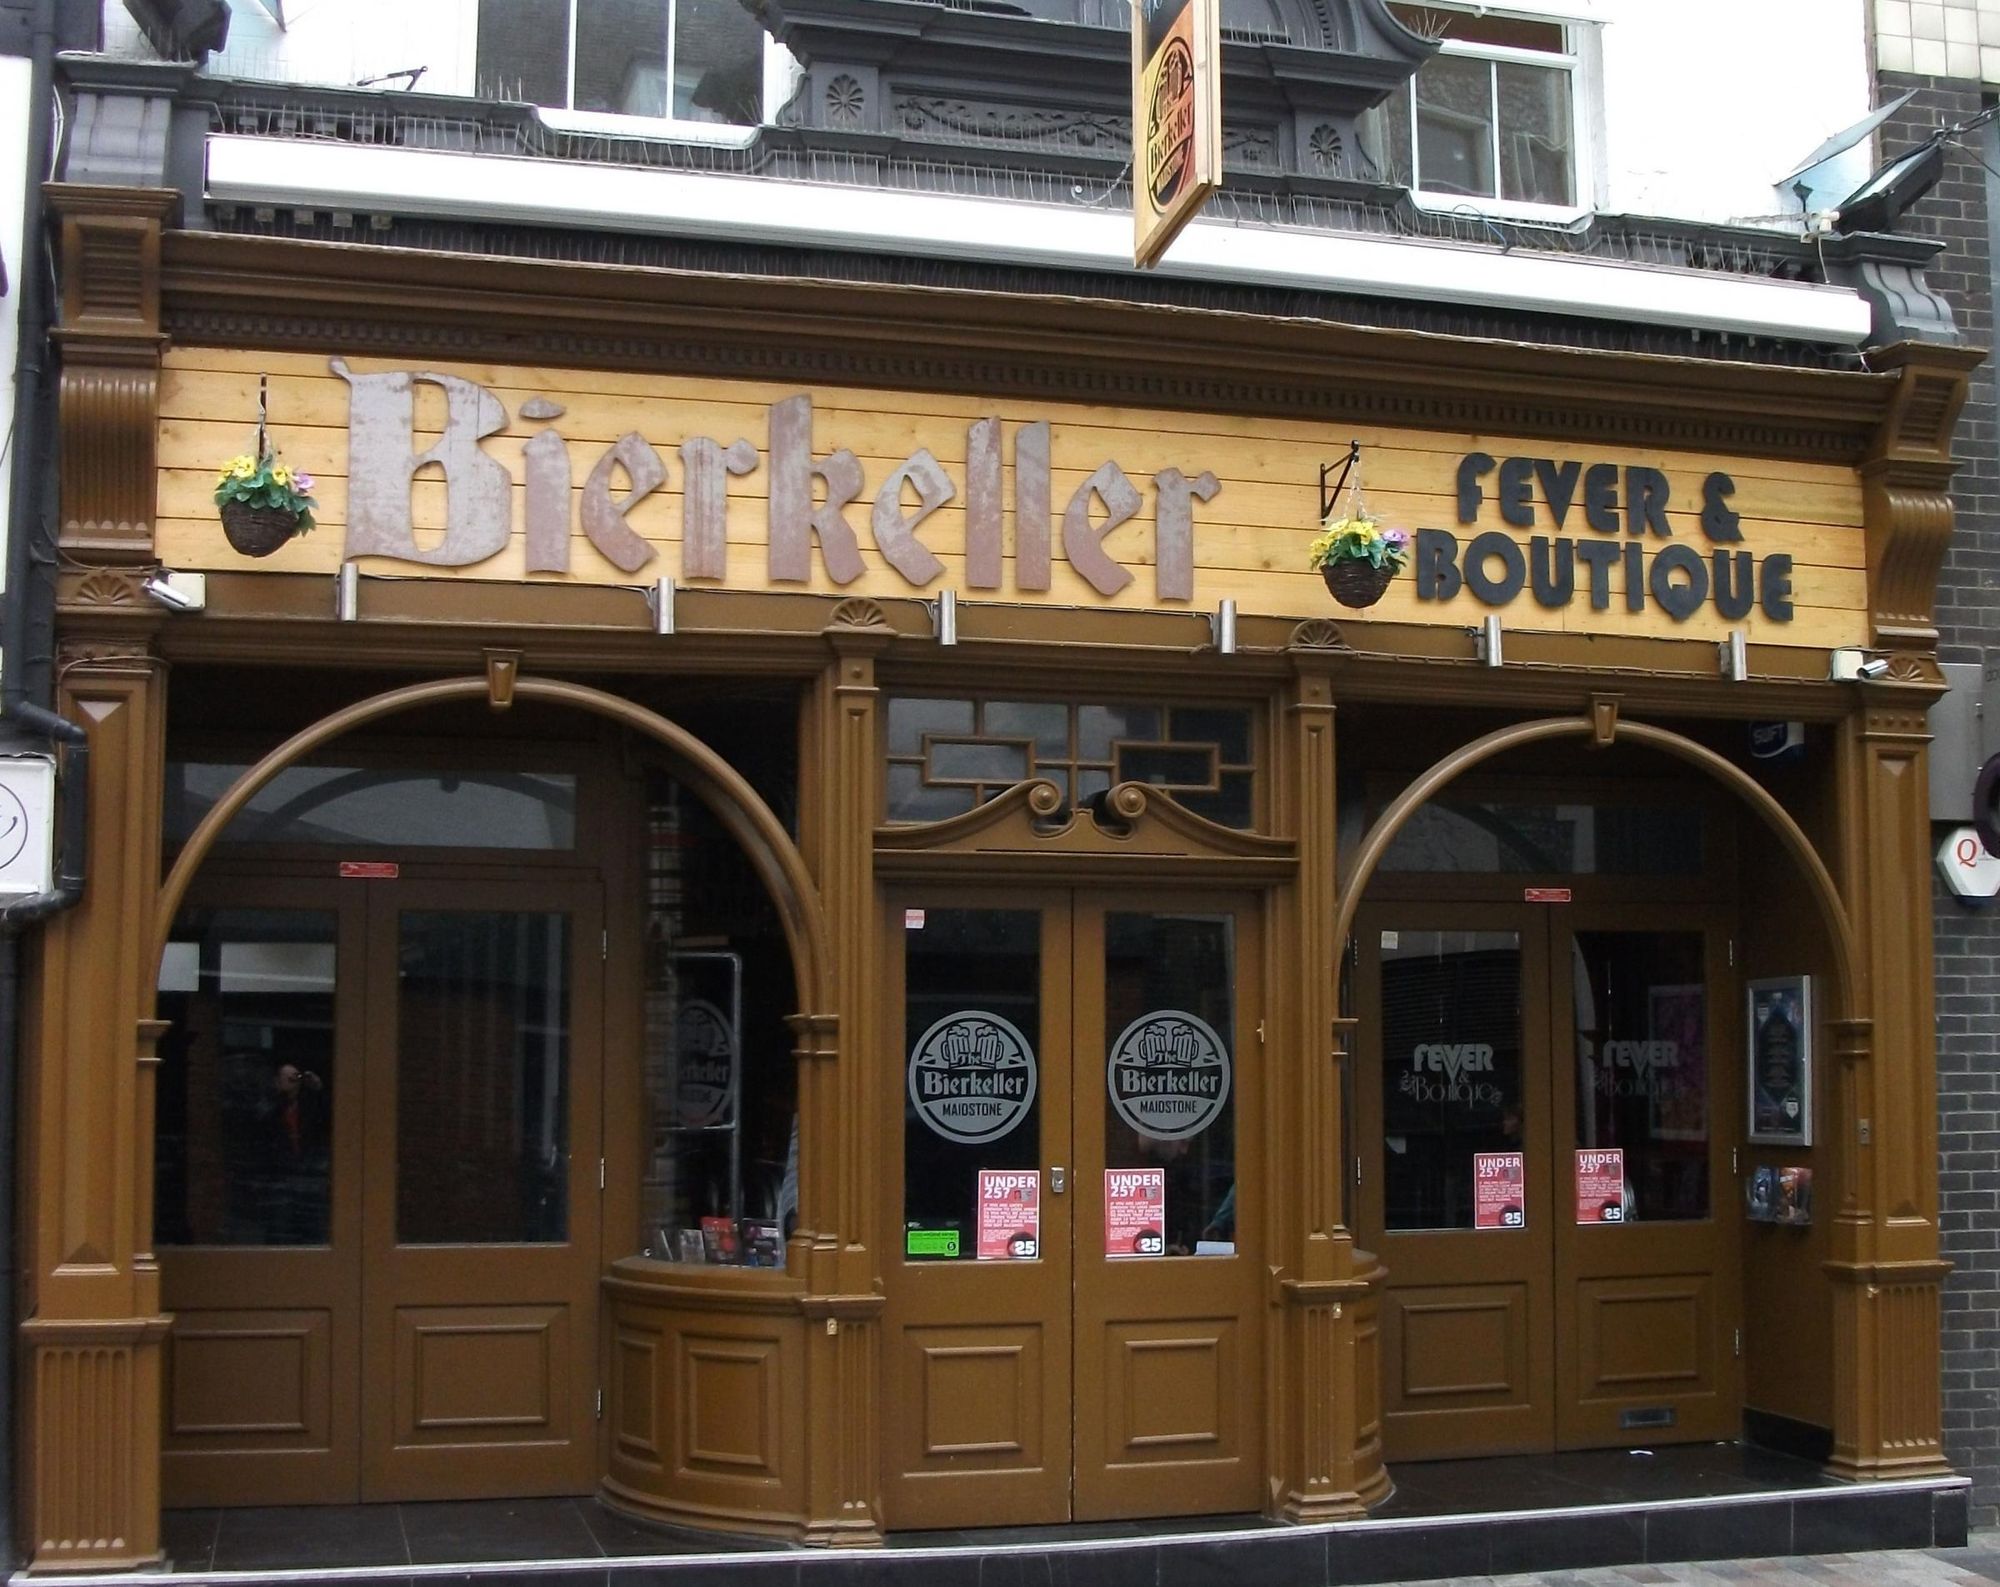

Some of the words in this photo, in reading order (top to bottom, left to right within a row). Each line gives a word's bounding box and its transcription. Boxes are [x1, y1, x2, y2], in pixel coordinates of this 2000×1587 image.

[328, 355, 1222, 601] Bierkeller
[1456, 452, 1672, 537] FEVER
[1701, 471, 1745, 542] &
[1416, 527, 1795, 623] BOUTIQUE
[1413, 1043, 1495, 1079] FEVER
[922, 1070, 1025, 1096] Bierkeller
[1120, 1069, 1219, 1094] Bierkeller
[942, 1102, 1003, 1117] MAIDSTONE
[1140, 1100, 1198, 1114] MAIDSTONE
[1478, 1157, 1521, 1168] UNDER
[1579, 1153, 1621, 1164] UNDER
[1479, 1167, 1500, 1178] 25?
[1579, 1163, 1601, 1174] 25?
[984, 1176, 1037, 1188] UNDER
[1110, 1174, 1162, 1187] UNDER
[984, 1187, 1010, 1199] 25?
[1110, 1186, 1136, 1198] 25?
[1504, 1211, 1522, 1225] 25
[1604, 1207, 1621, 1220] 25
[1014, 1240, 1036, 1256] 25
[1140, 1237, 1162, 1252] 25
